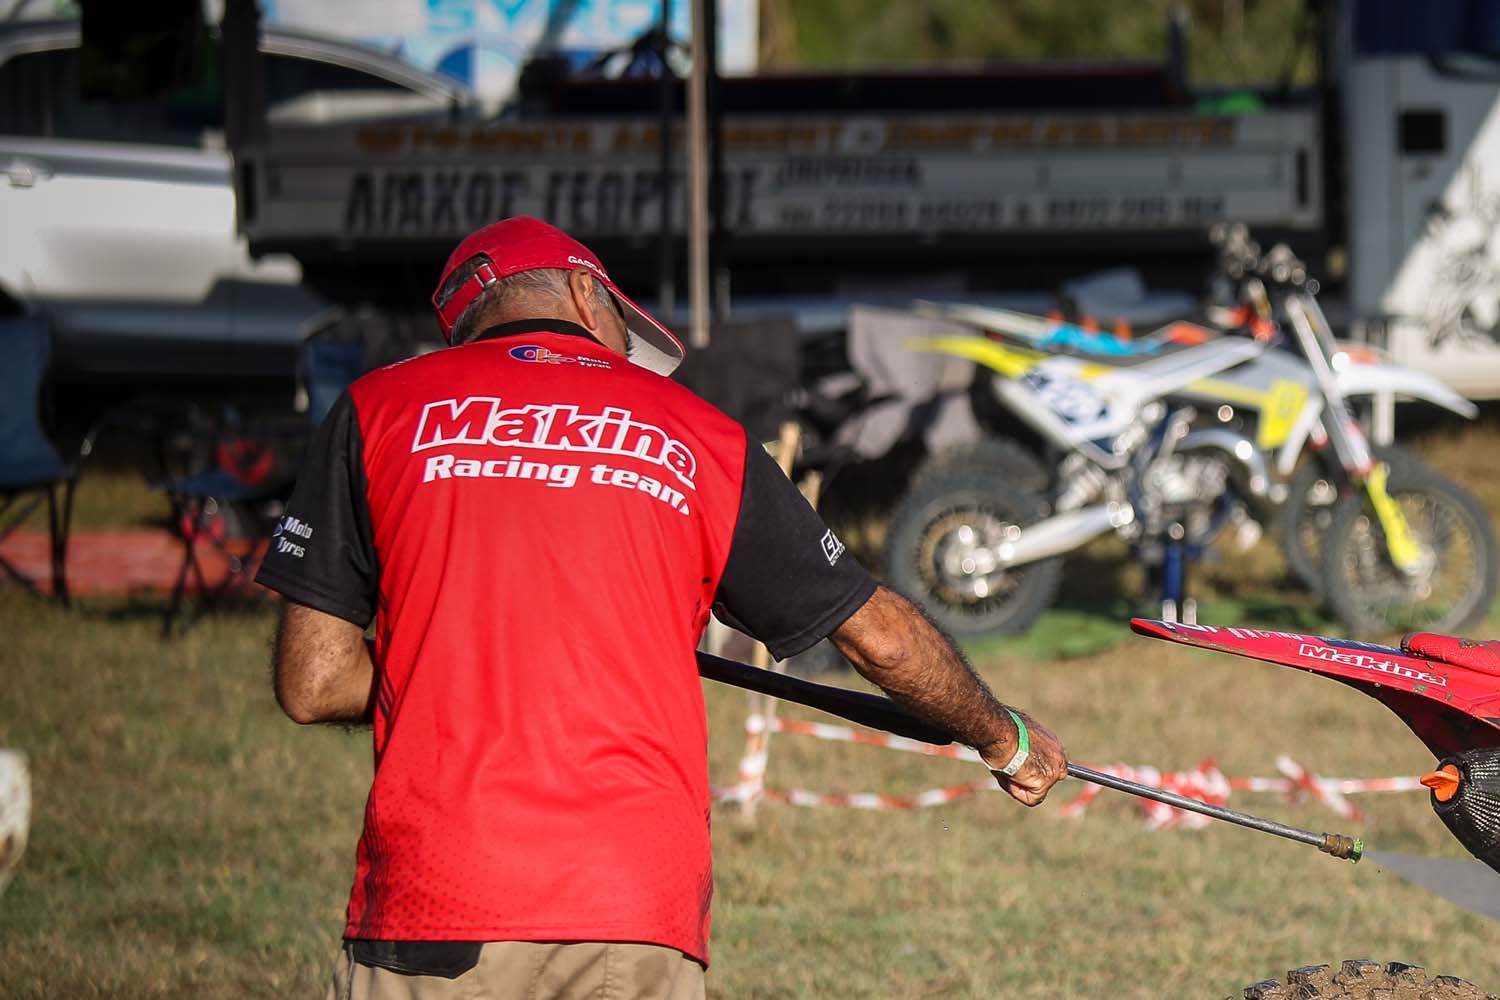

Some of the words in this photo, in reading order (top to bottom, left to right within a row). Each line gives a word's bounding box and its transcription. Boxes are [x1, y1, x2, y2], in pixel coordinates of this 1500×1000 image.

[411, 396, 696, 490] Makina
[422, 454, 580, 488] Racing
[284, 516, 313, 539] Moto
[277, 536, 306, 558] Tyres
[1299, 643, 1447, 687] Makina
